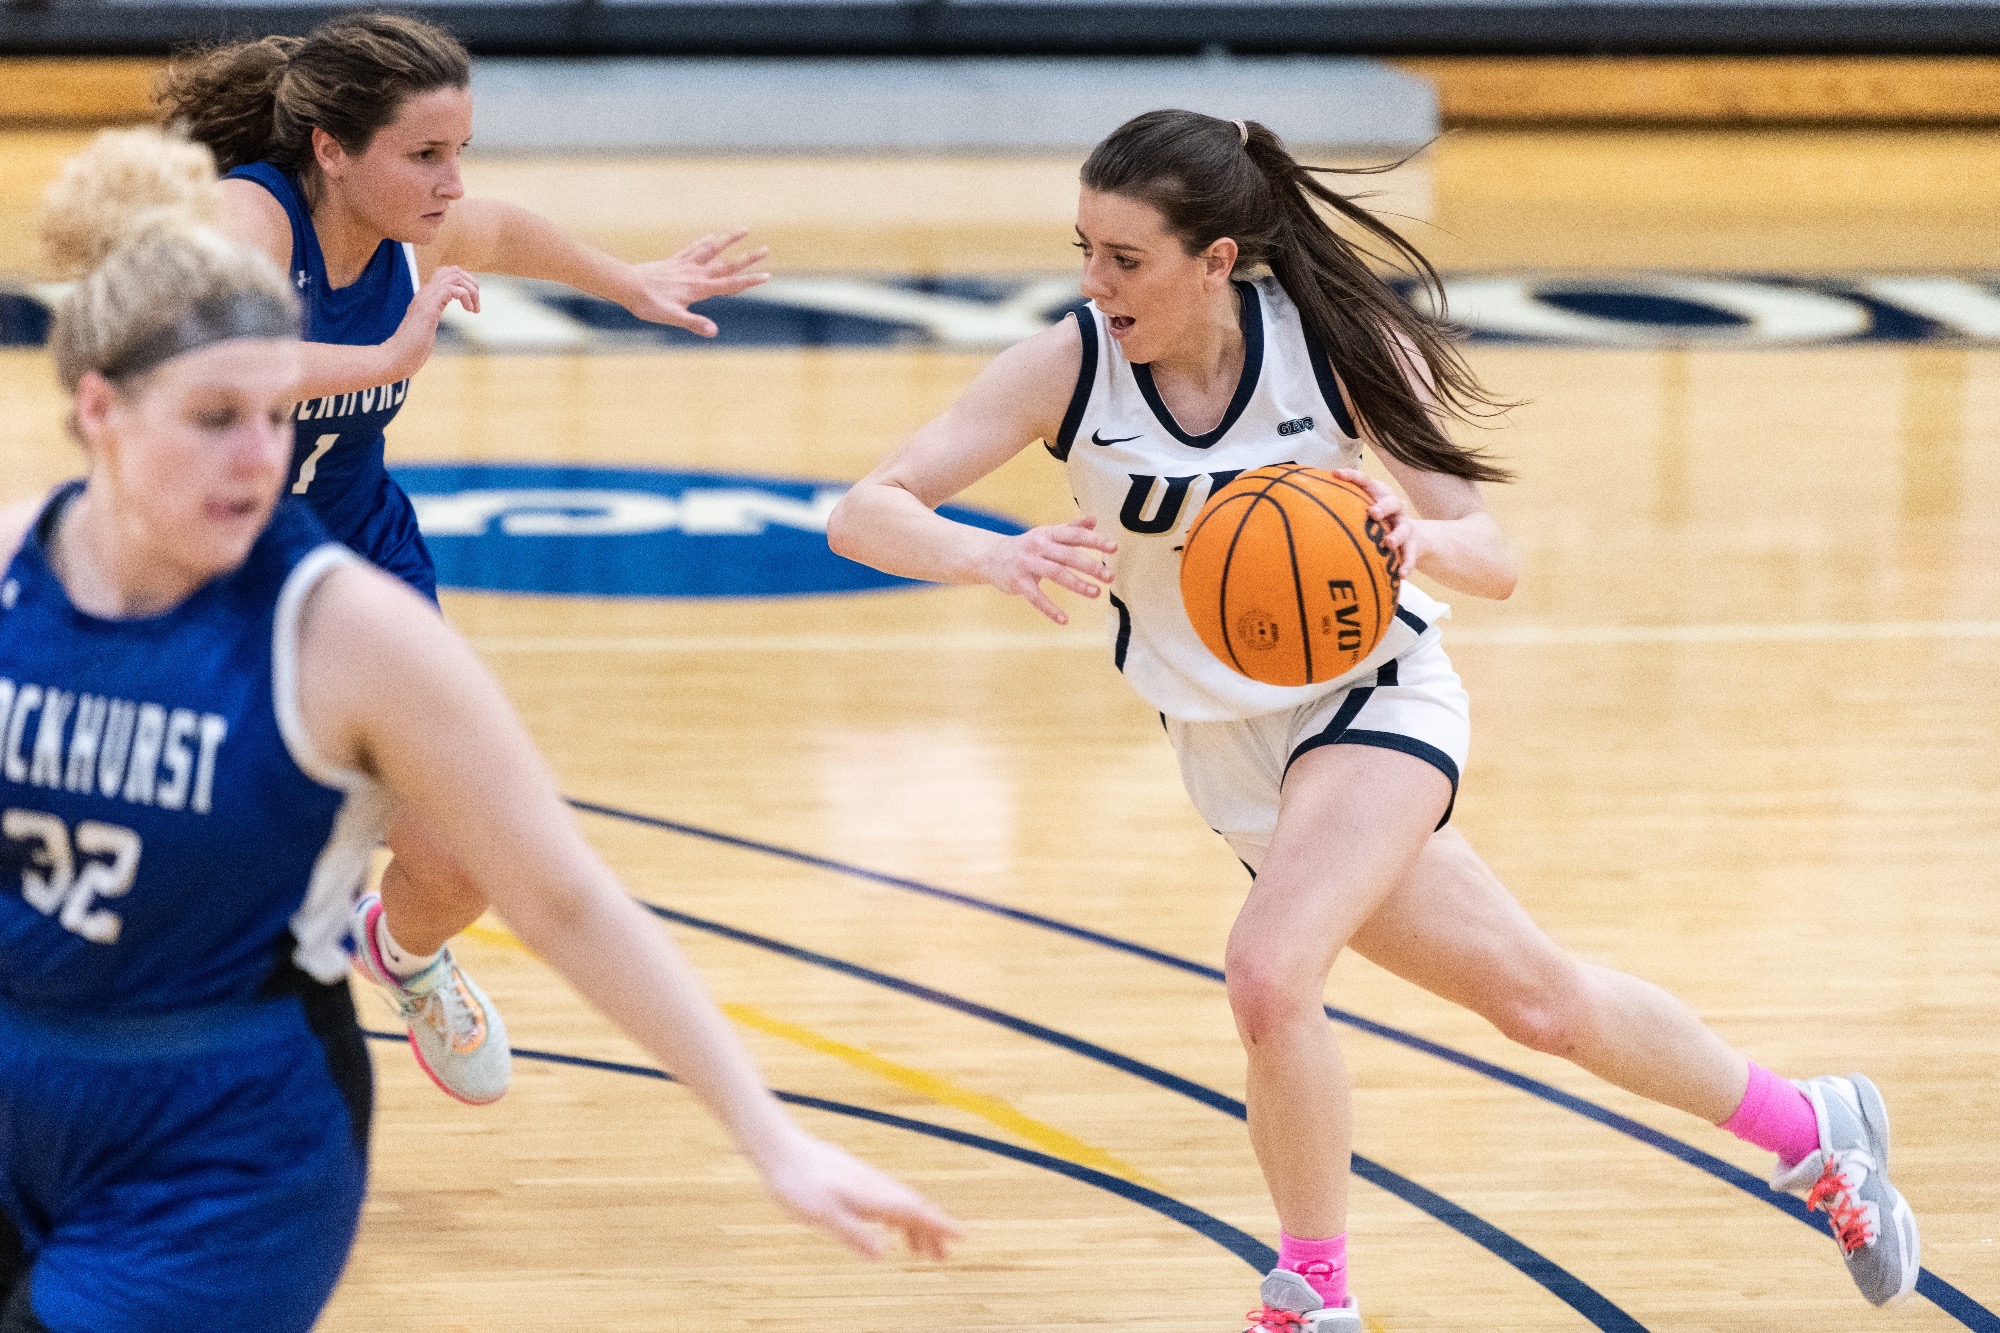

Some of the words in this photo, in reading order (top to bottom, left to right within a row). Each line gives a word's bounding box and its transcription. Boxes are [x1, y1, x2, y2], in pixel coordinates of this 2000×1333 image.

[291, 433, 341, 495] 1
[1328, 579, 1361, 652] EVO
[1, 808, 142, 945] 32
